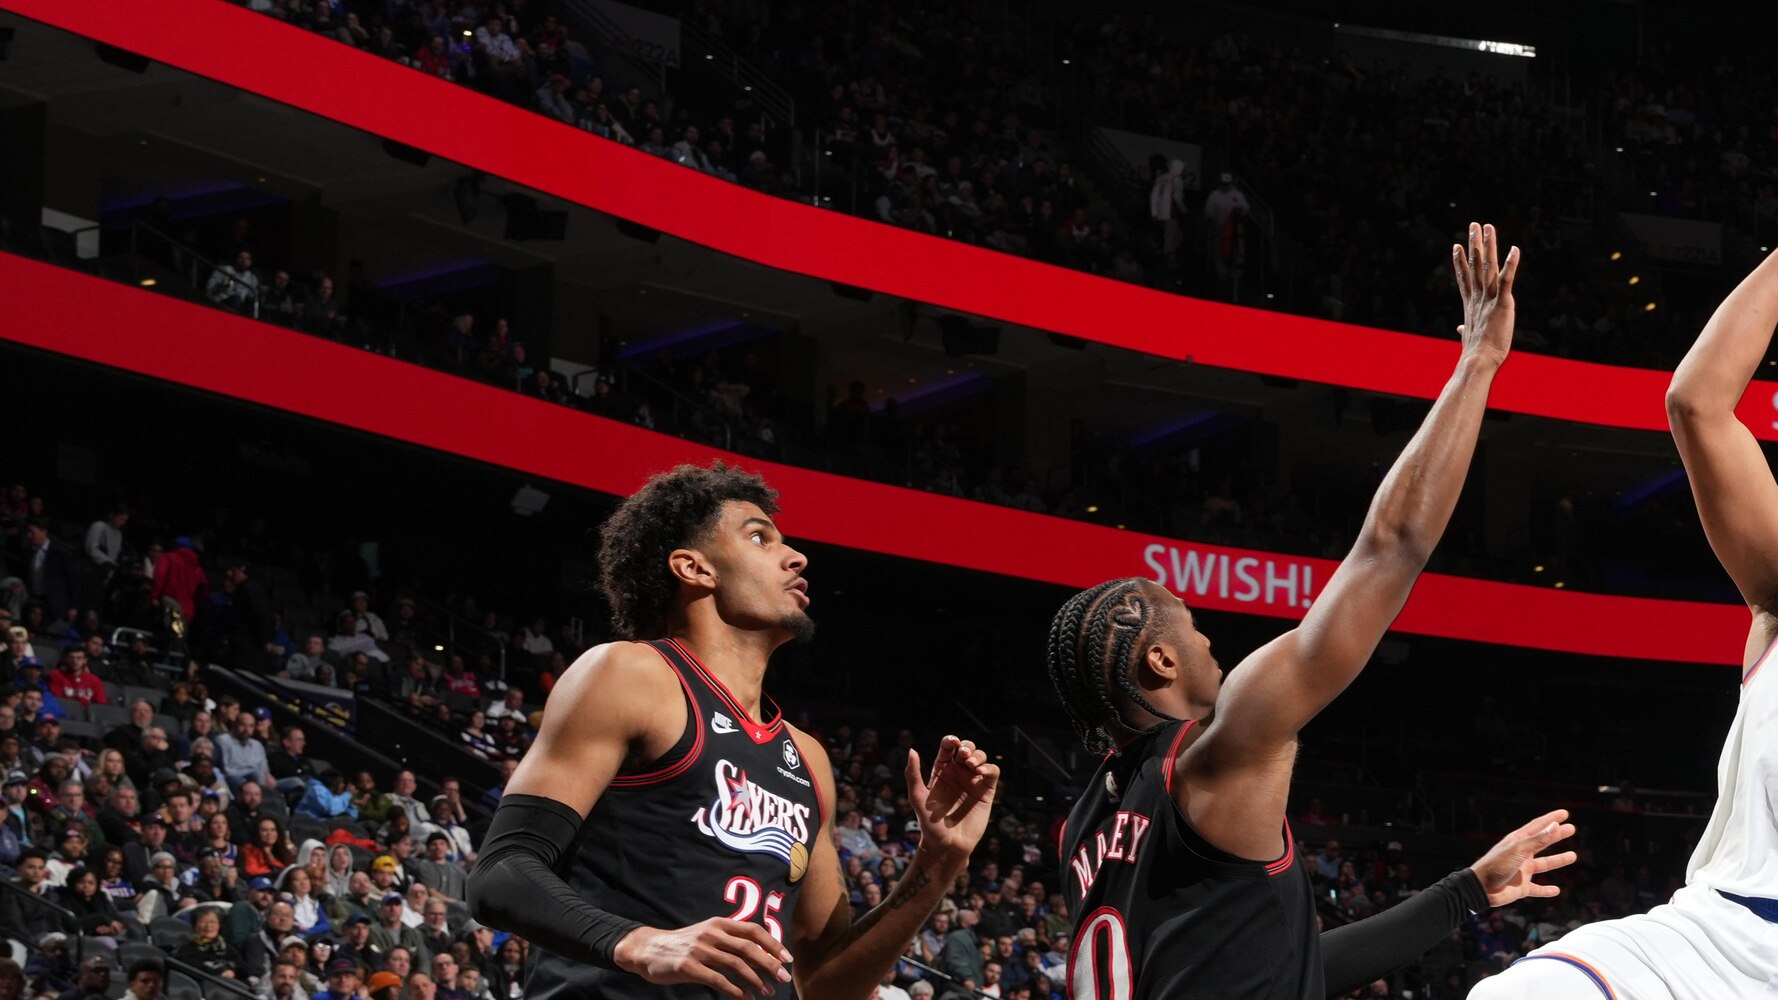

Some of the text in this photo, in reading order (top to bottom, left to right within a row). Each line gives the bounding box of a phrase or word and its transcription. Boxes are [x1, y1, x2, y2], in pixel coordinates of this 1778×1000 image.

[1144, 543, 1312, 609] SWISH!
[776, 766, 811, 788] crypto.com
[724, 875, 786, 949] 25
